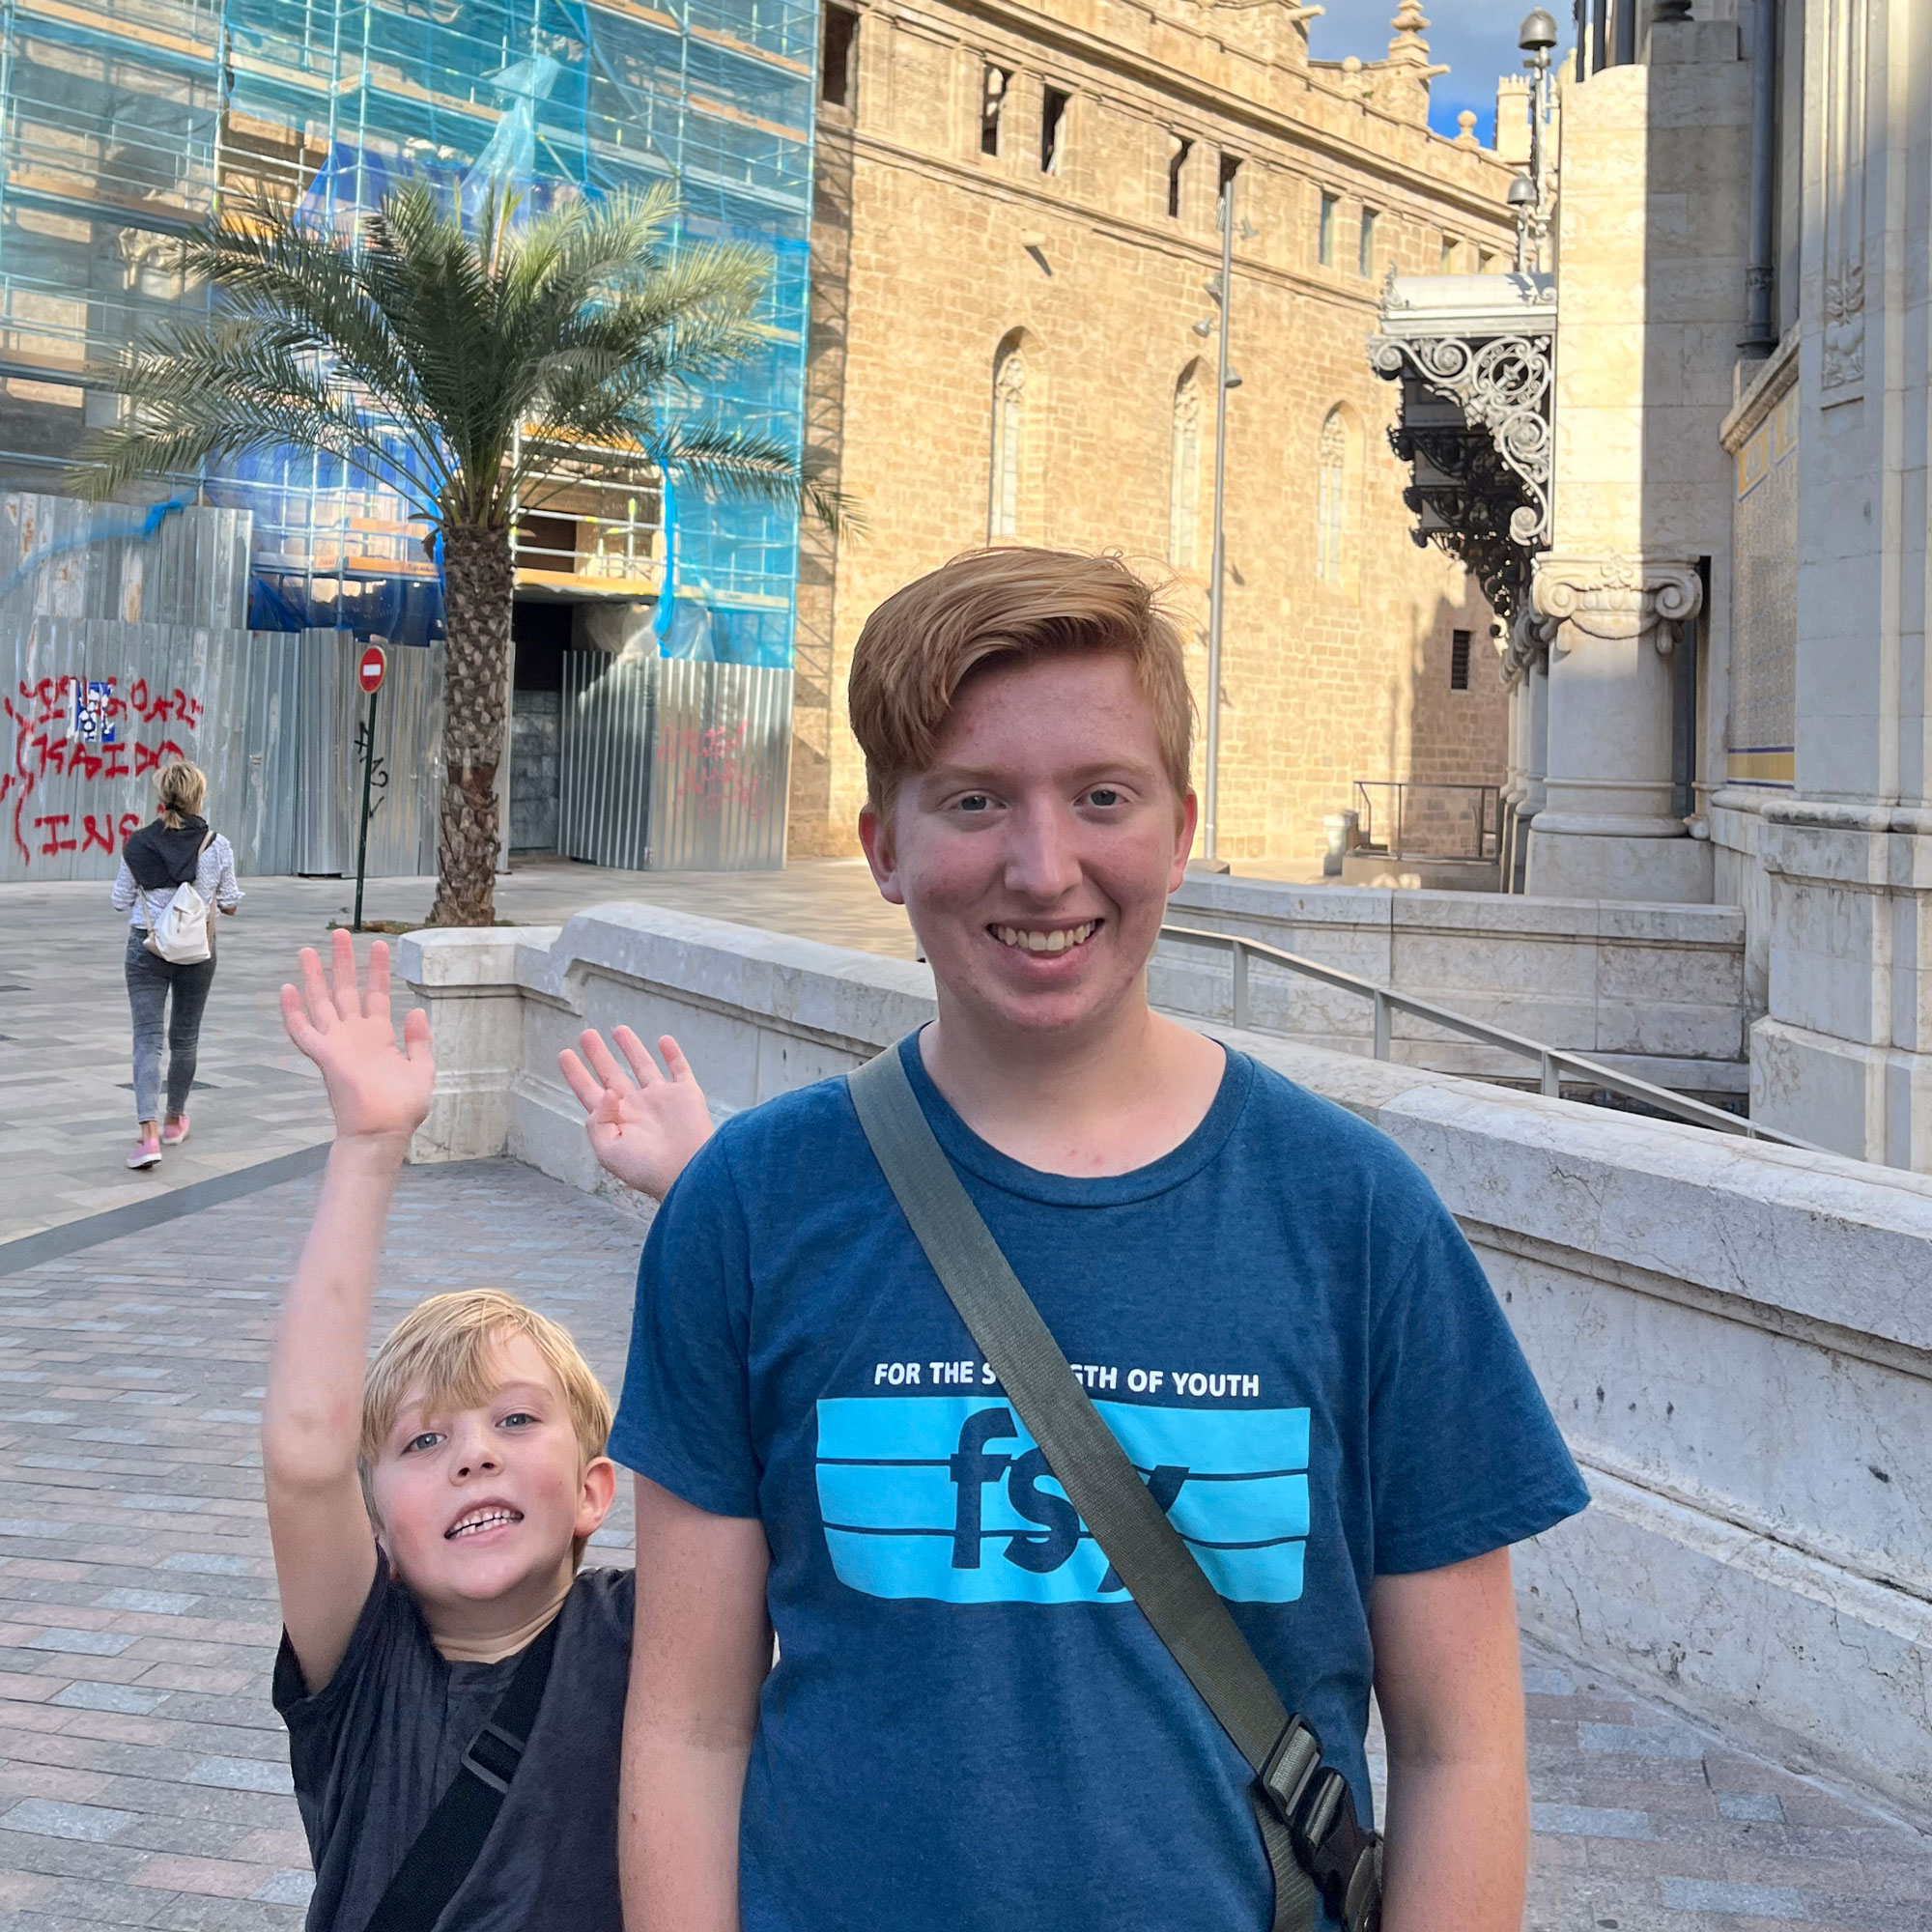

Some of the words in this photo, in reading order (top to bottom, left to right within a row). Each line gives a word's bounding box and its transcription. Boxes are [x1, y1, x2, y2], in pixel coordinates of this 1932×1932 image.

[874, 1362, 921, 1385] FOR
[929, 1360, 974, 1384] THE
[981, 1362, 1119, 1390] SGTH
[1127, 1368, 1164, 1393] OF
[1171, 1372, 1260, 1397] YOUTH
